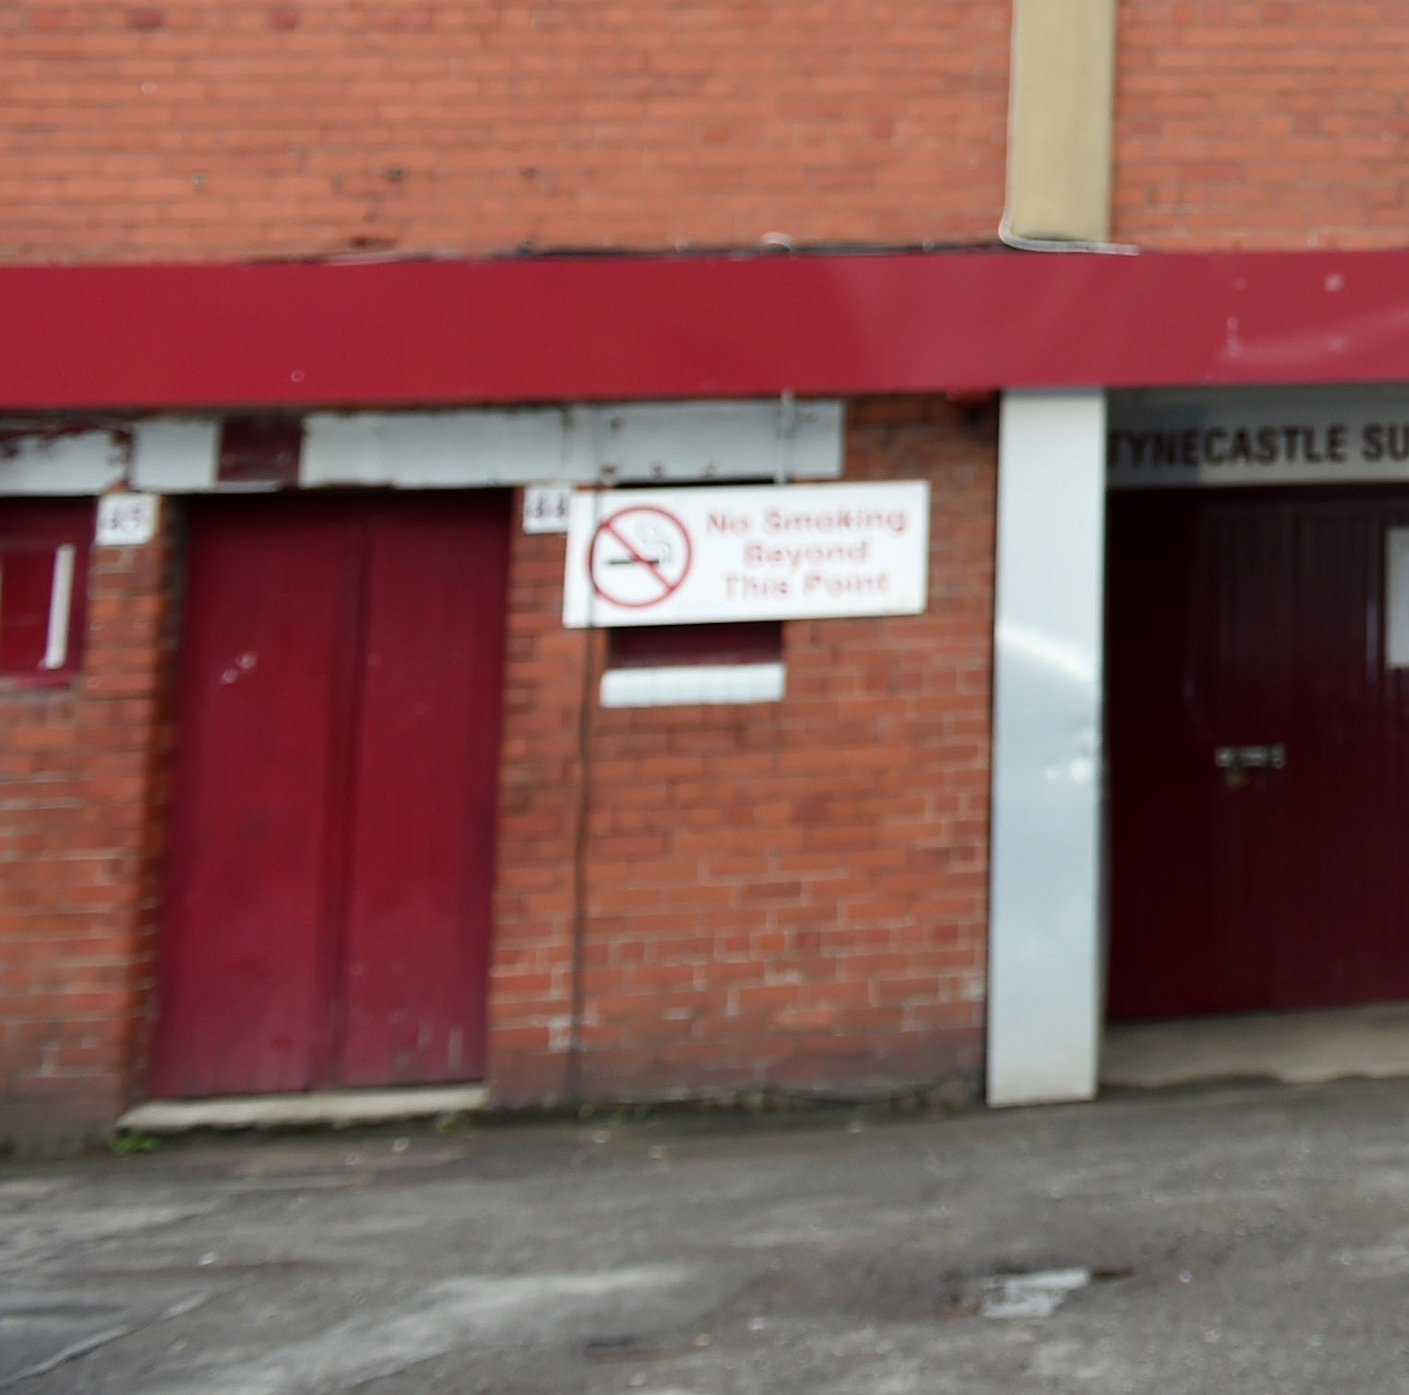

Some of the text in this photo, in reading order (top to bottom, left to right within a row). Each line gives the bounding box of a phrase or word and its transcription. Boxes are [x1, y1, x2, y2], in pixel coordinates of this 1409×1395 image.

[1109, 425, 1347, 468] TYNECASTLE
[706, 506, 909, 535] No Smoking
[743, 540, 870, 569] Beyond
[724, 571, 890, 599] This Point
